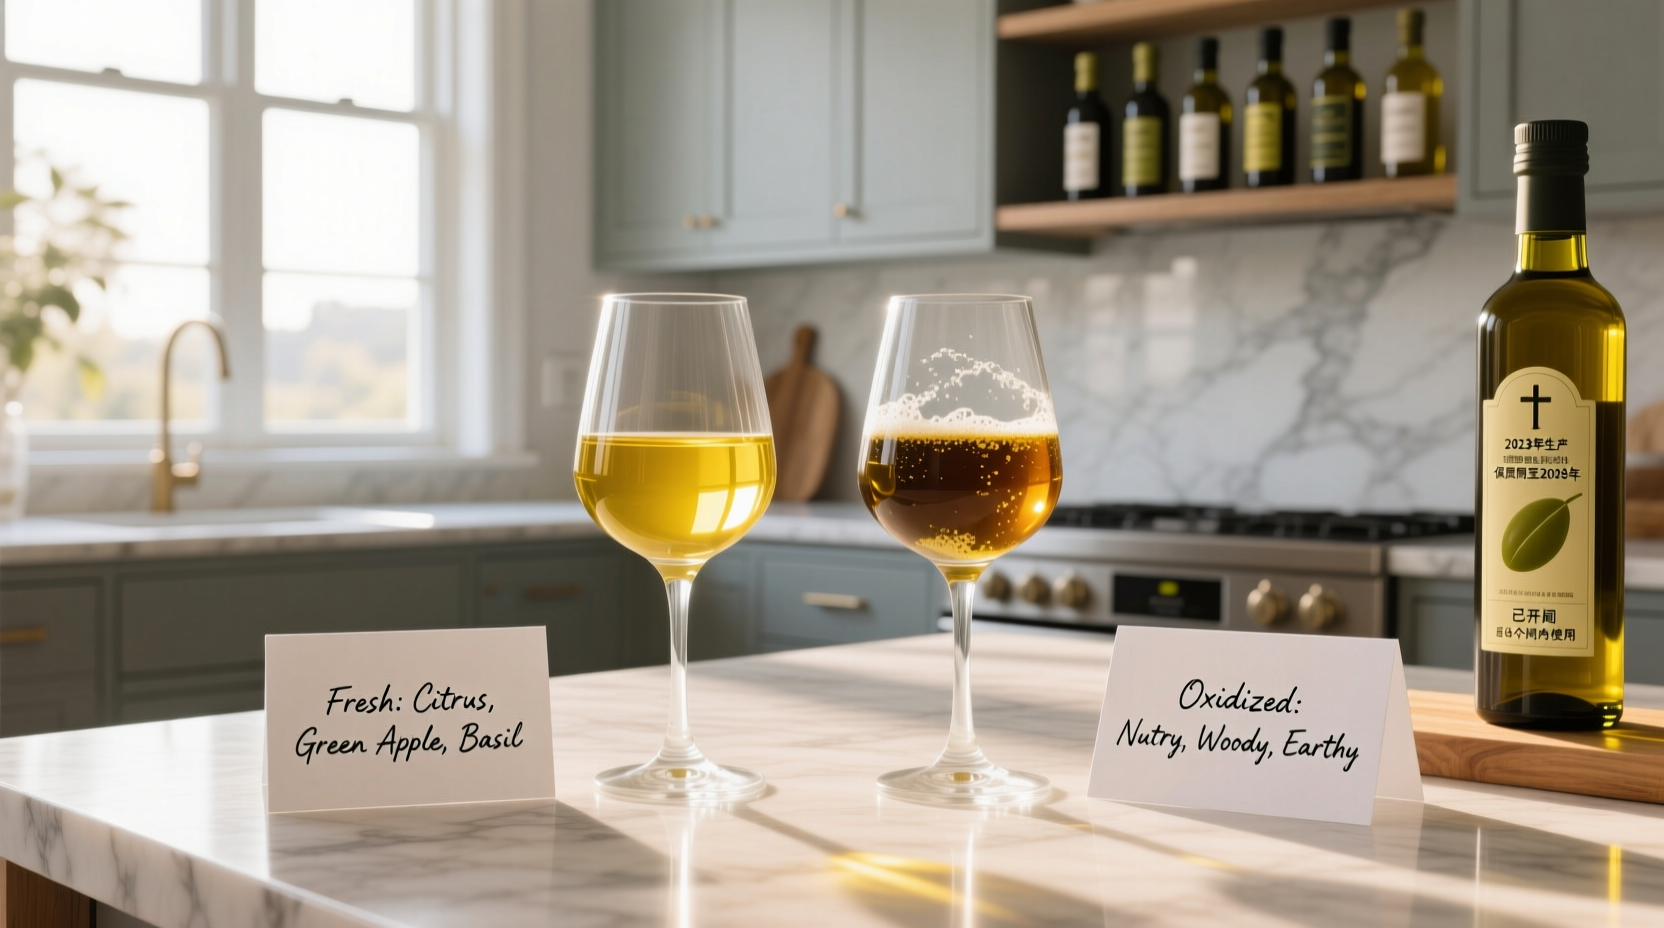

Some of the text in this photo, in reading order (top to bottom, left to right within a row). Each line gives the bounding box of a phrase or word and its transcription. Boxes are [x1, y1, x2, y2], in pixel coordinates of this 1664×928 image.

[326, 682, 494, 715] Fresh: Citrus,
[1179, 679, 1302, 713] Oxidized:
[295, 722, 524, 766] Green Apple, Basil
[1117, 719, 1359, 772] Nutry, Woody, Earthy
